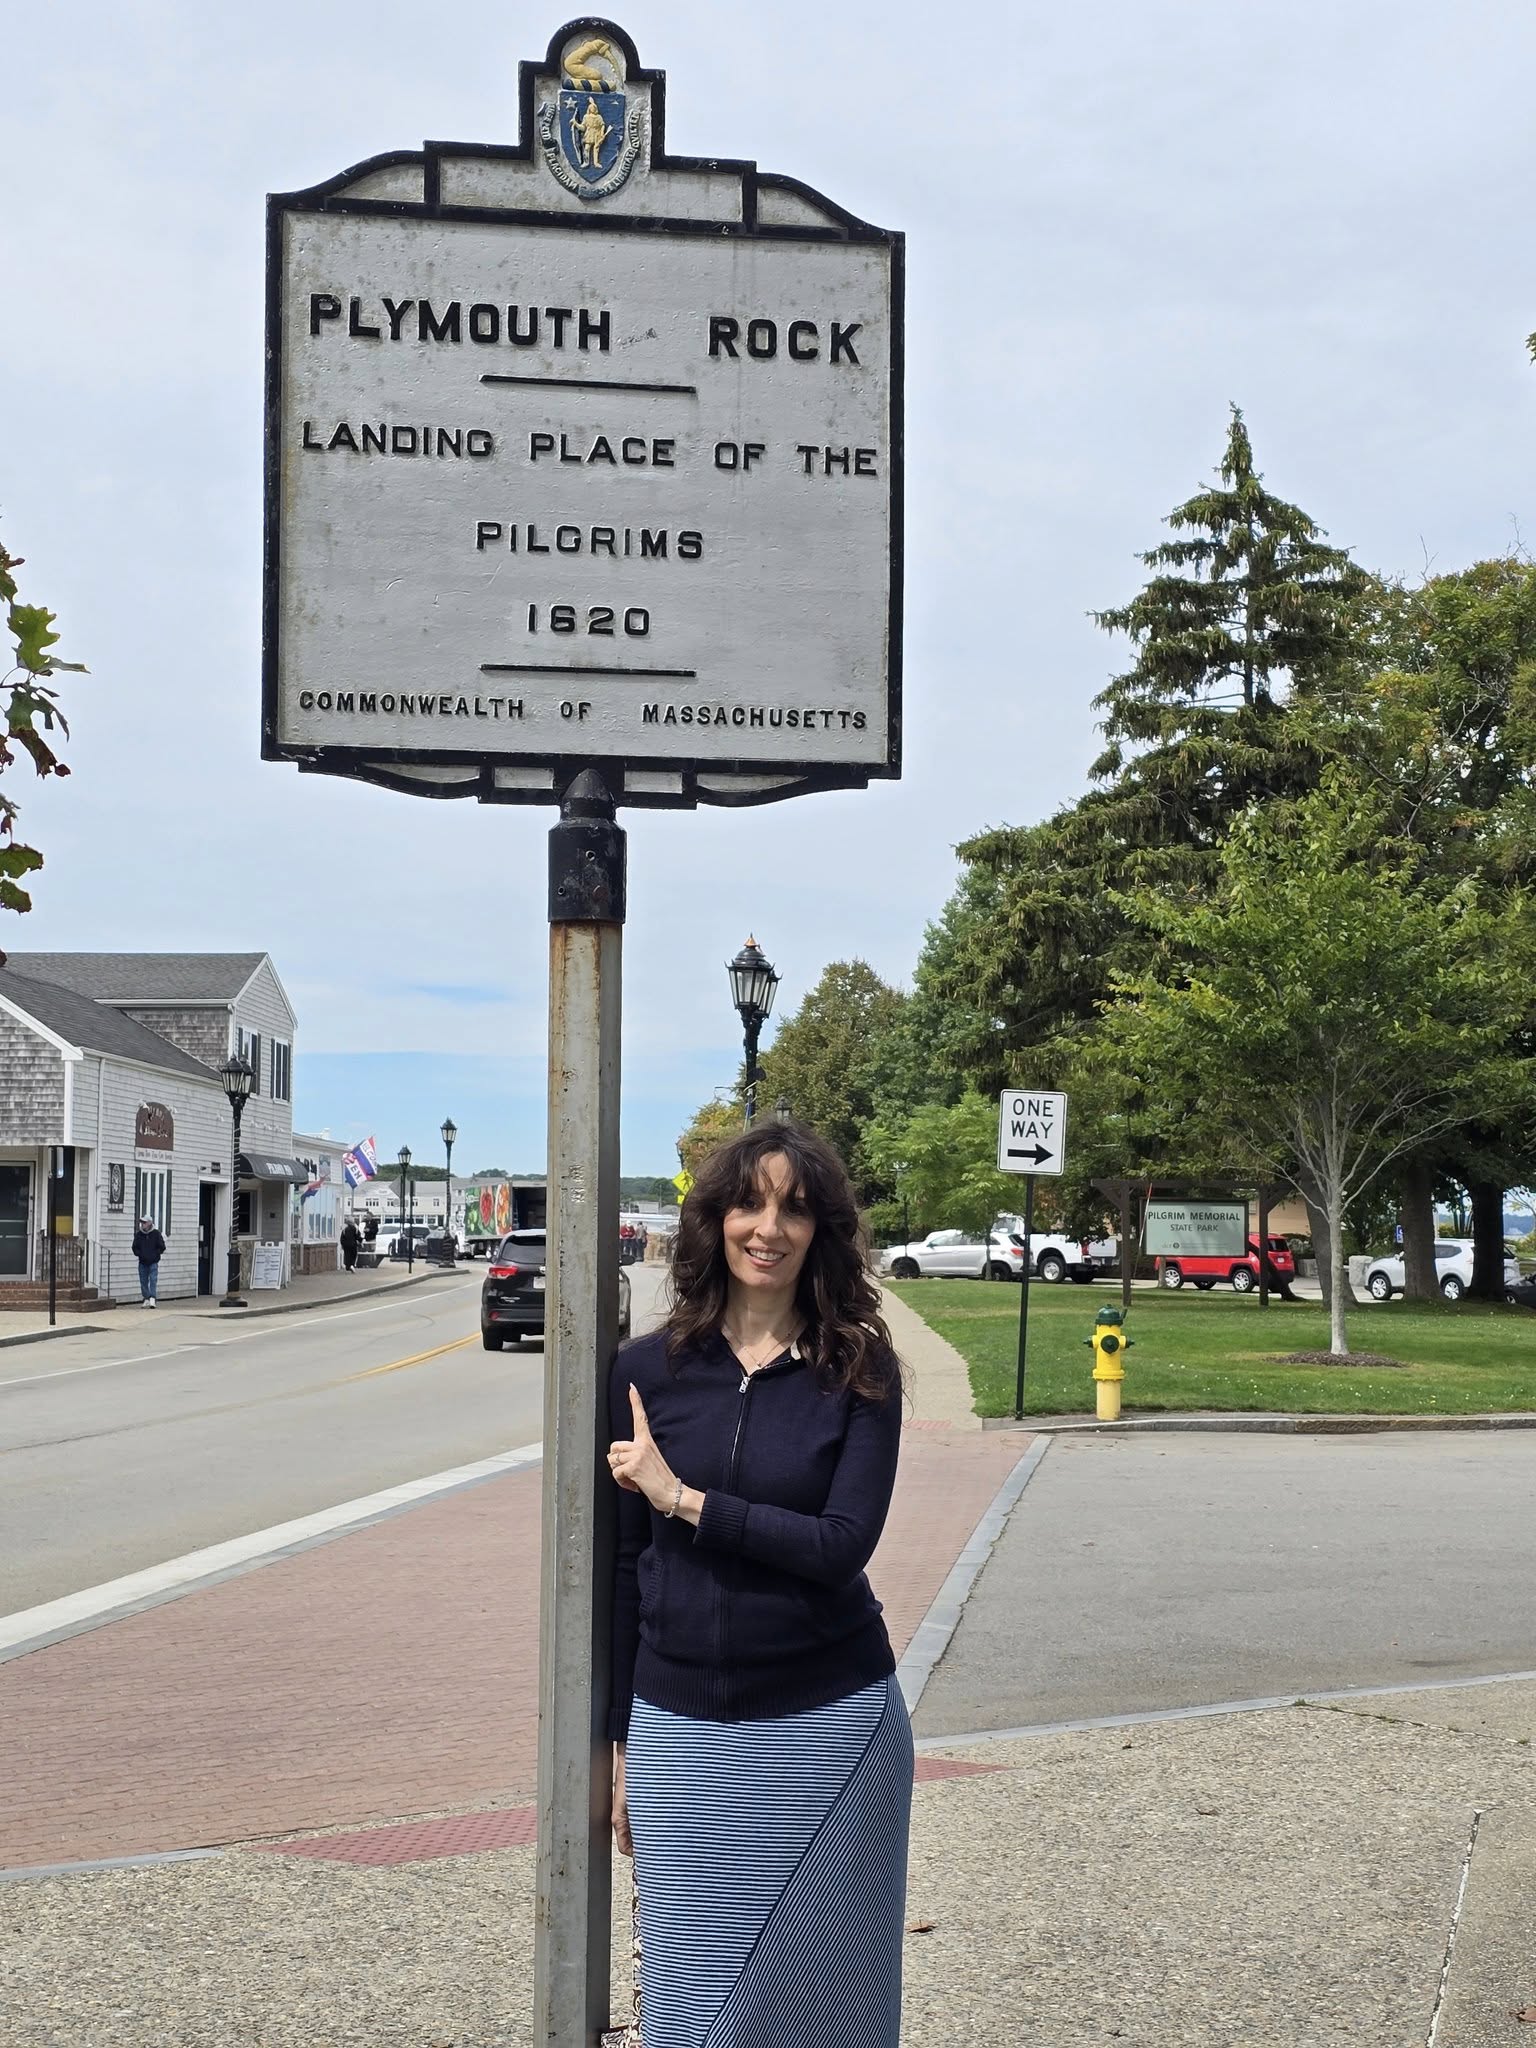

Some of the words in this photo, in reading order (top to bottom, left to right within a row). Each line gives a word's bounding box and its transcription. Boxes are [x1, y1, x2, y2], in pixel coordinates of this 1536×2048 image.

[309, 293, 610, 351] PLYMOUTH
[708, 316, 863, 366] ROCK
[302, 421, 495, 457] LANDING
[529, 432, 675, 466] PLACE
[714, 442, 766, 470] OF
[797, 445, 877, 476] THE
[476, 521, 703, 558] PILGRIMS
[528, 603, 650, 636] 1620
[300, 690, 523, 718] COMMONWEALTH
[560, 701, 592, 720] OF
[642, 704, 866, 729] MASSACHUSETTS
[1012, 1098, 1054, 1117] ONE
[1011, 1120, 1054, 1139] WAY
[1148, 1211, 1185, 1220] PILGRIM
[1190, 1211, 1240, 1221] MEMORIAL
[1170, 1224, 1193, 1232] STATE
[1196, 1224, 1218, 1232] PARK
